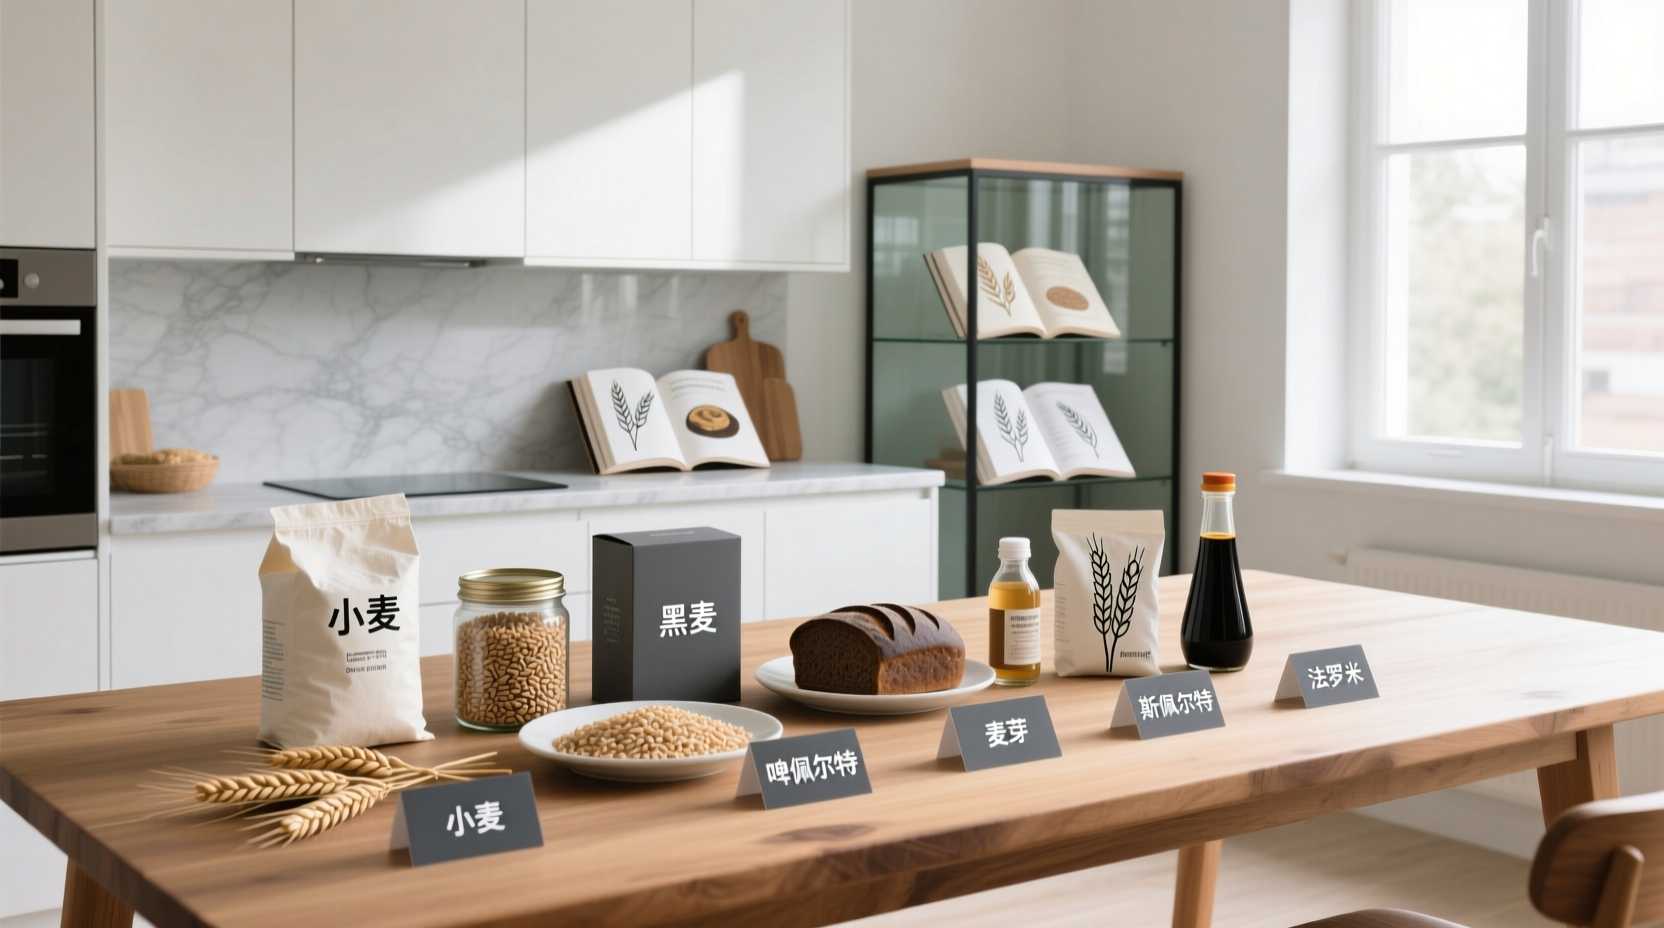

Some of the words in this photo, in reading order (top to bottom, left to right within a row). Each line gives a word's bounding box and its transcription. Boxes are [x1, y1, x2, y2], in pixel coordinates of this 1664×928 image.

[328, 594, 400, 636] 小麦
[659, 600, 717, 638] 黑麦
[1307, 661, 1365, 690] 法罗米
[1138, 688, 1214, 721] 斯佩尔特
[985, 718, 1029, 748] 麦芽
[765, 749, 858, 786] 啤佩尔特
[446, 800, 506, 837] 小麦
